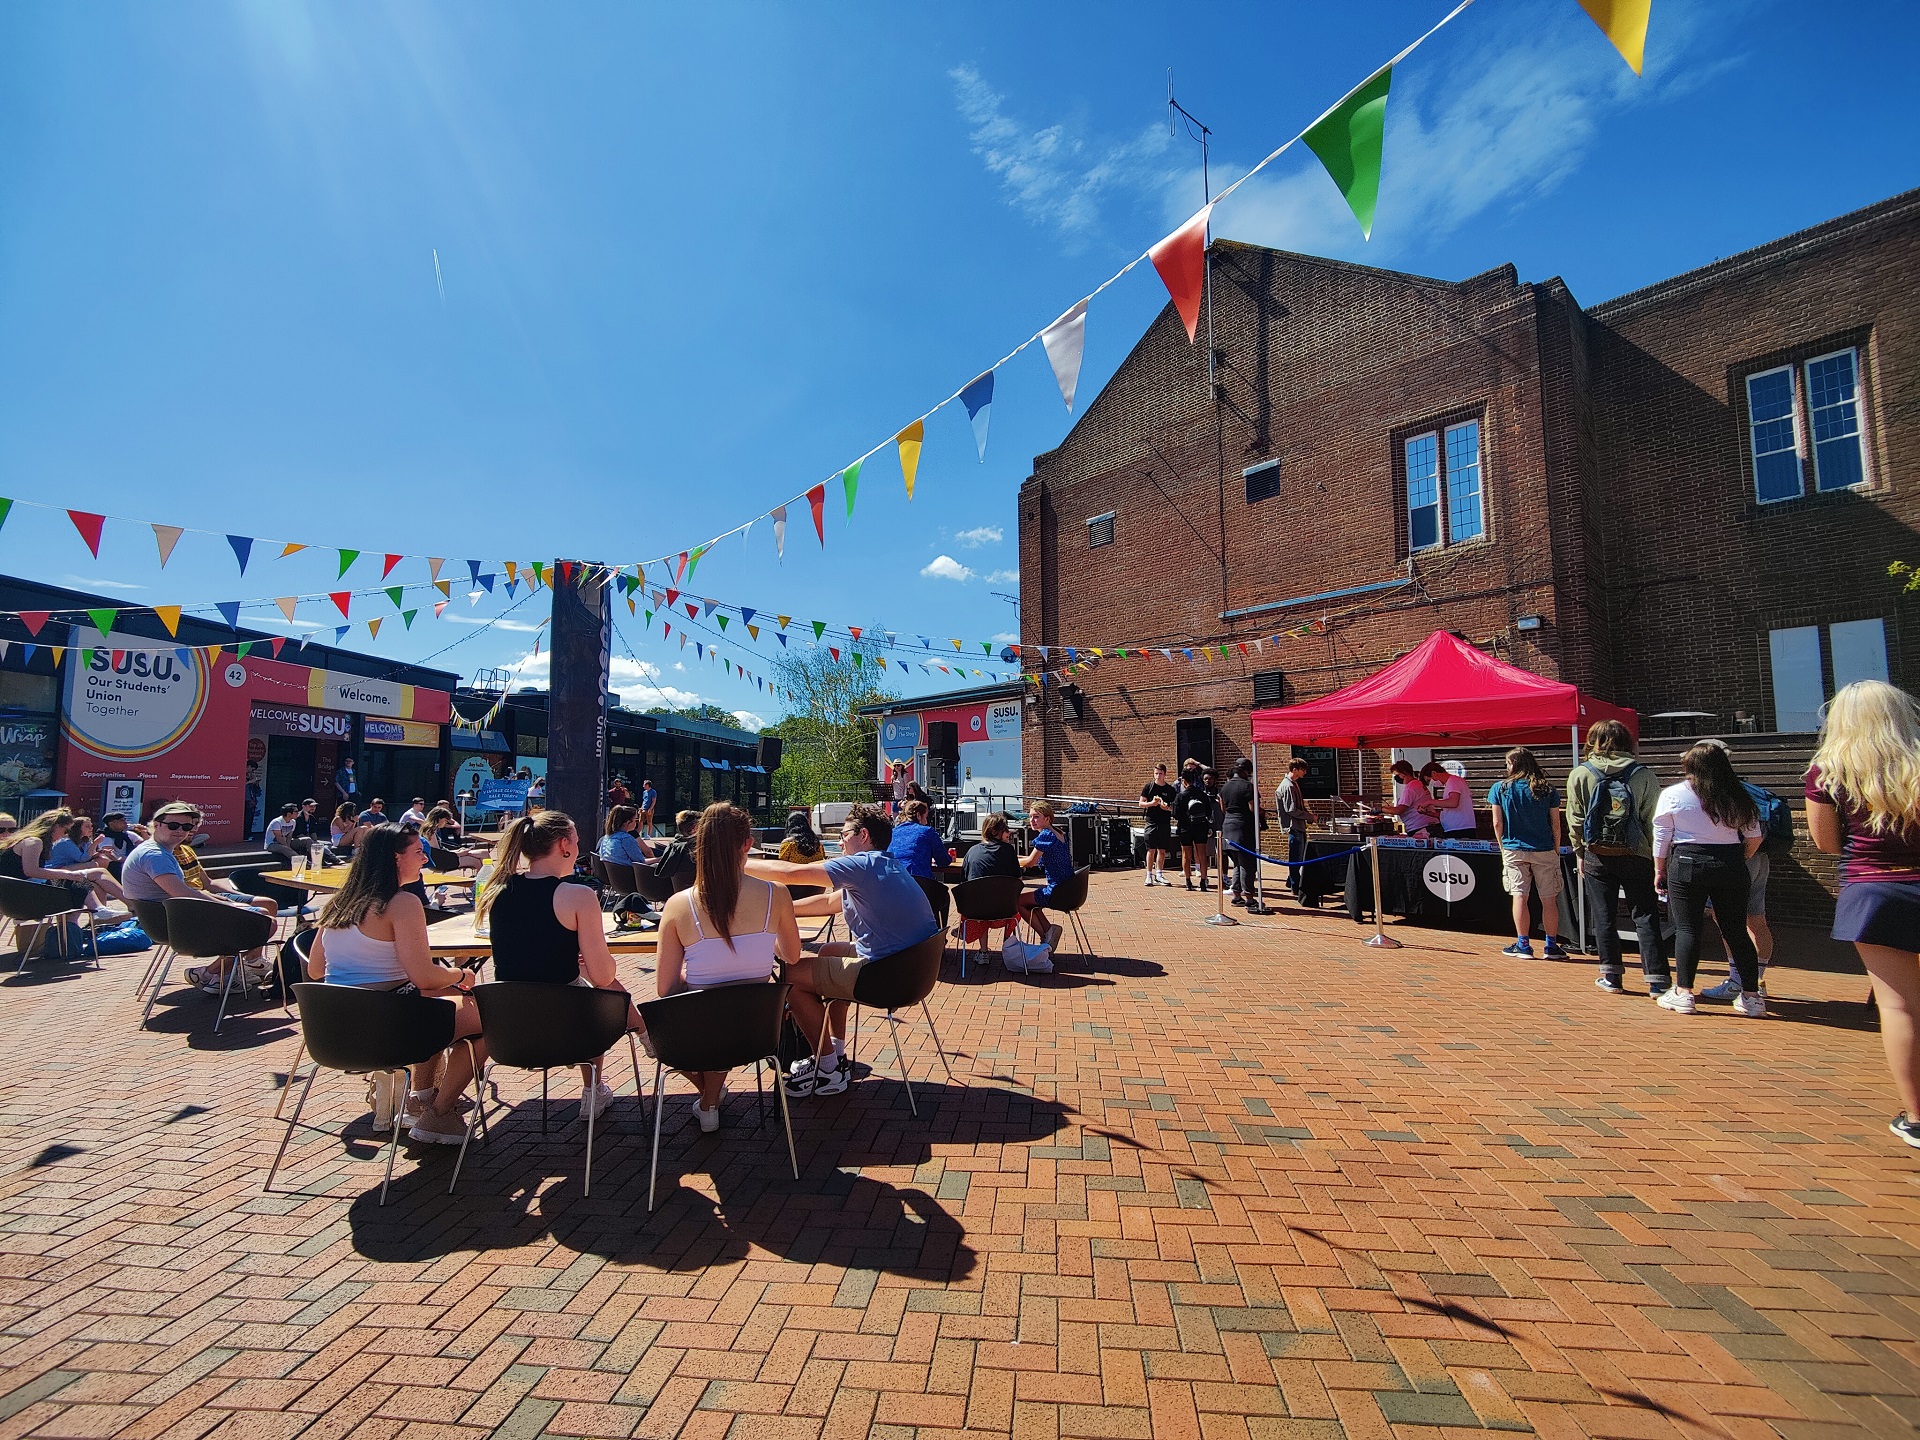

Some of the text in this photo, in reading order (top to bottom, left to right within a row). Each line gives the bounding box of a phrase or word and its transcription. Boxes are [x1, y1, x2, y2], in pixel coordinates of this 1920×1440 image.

[89, 645, 181, 682] SUSU.
[228, 670, 242, 680] 42
[88, 675, 171, 694] Our Students'
[86, 688, 122, 702] Union
[339, 687, 391, 705] Welcome.
[86, 702, 139, 717] Together
[993, 706, 1019, 718] SUSU.
[250, 708, 346, 736] WELCOME TO SUSU
[364, 722, 403, 734] WELCOME
[1428, 871, 1469, 885] SUSU
